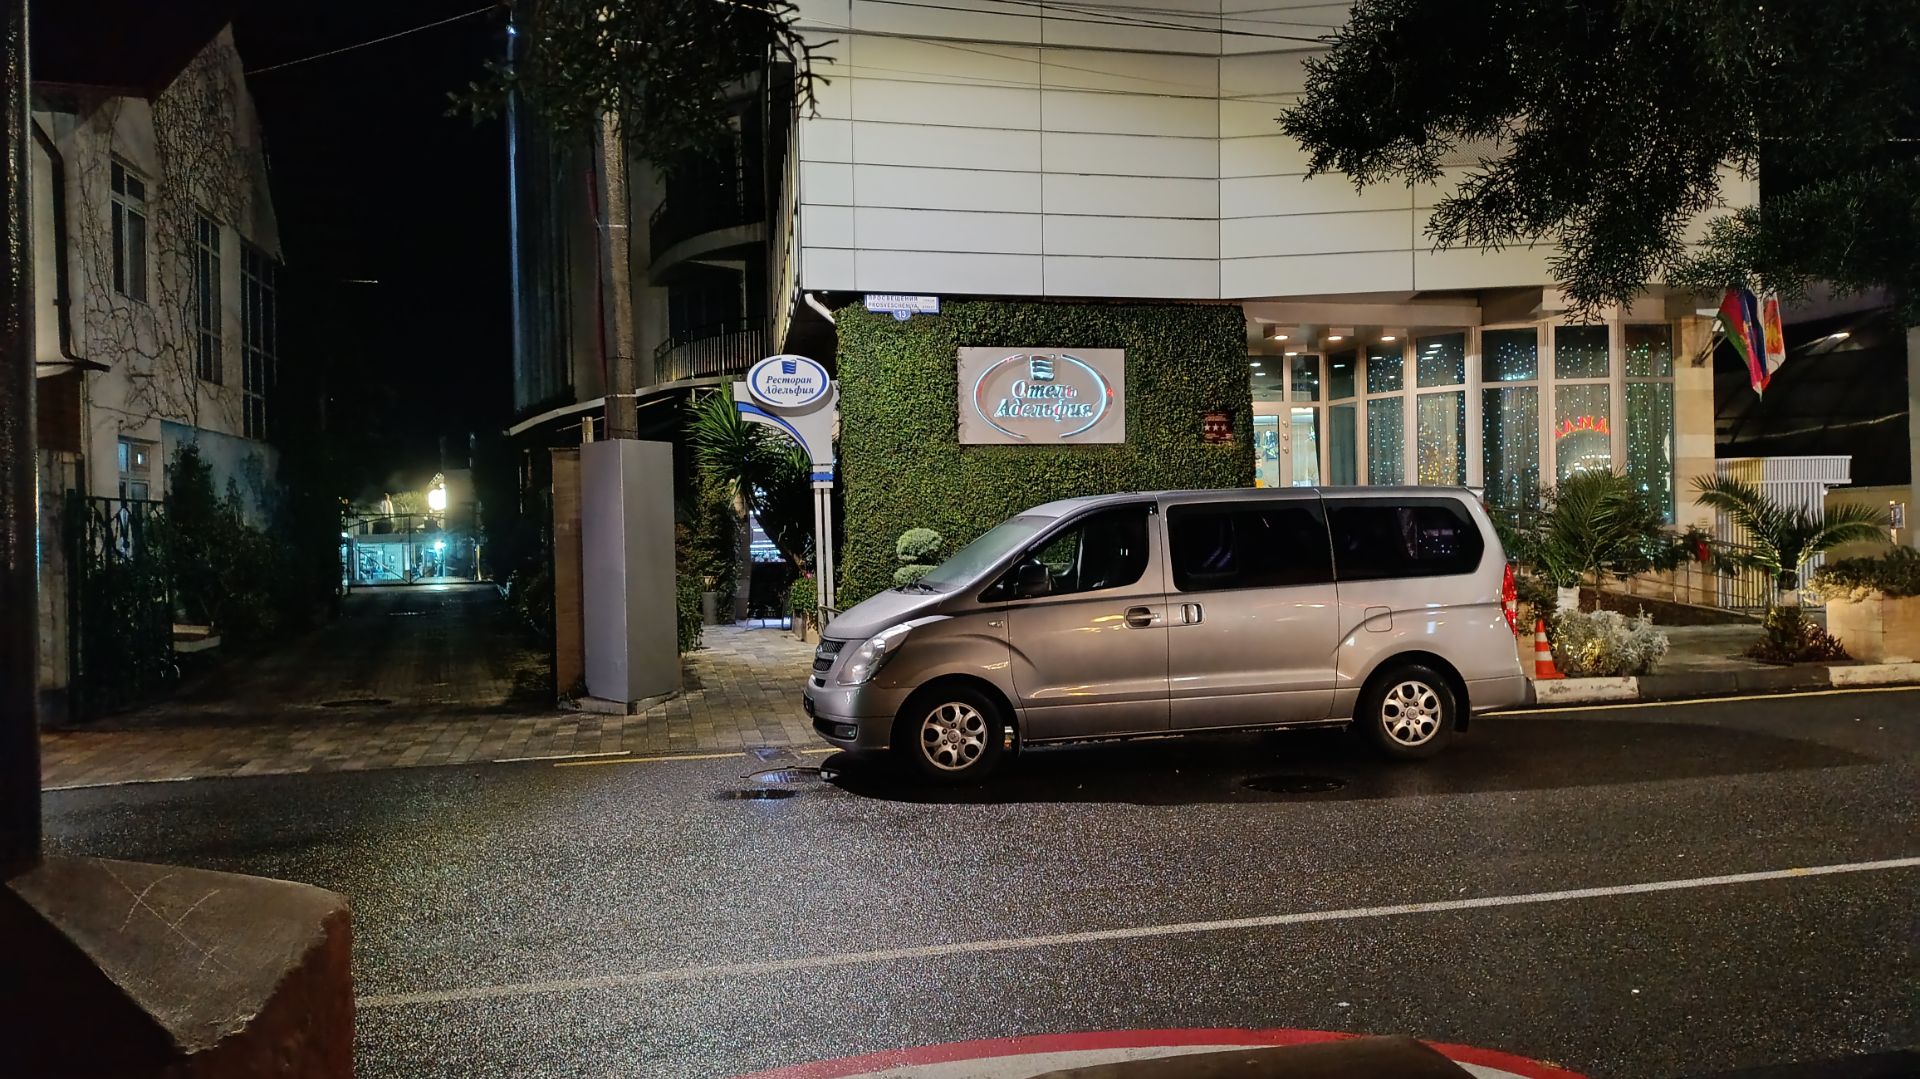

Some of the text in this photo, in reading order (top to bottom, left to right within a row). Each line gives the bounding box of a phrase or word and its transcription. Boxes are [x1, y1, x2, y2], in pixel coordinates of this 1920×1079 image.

[898, 310, 907, 318] 13
[766, 375, 812, 386] Ресторан
[764, 385, 815, 396] Адельфия
[1011, 379, 1078, 399] Отель
[993, 398, 1094, 422] Адельфия
